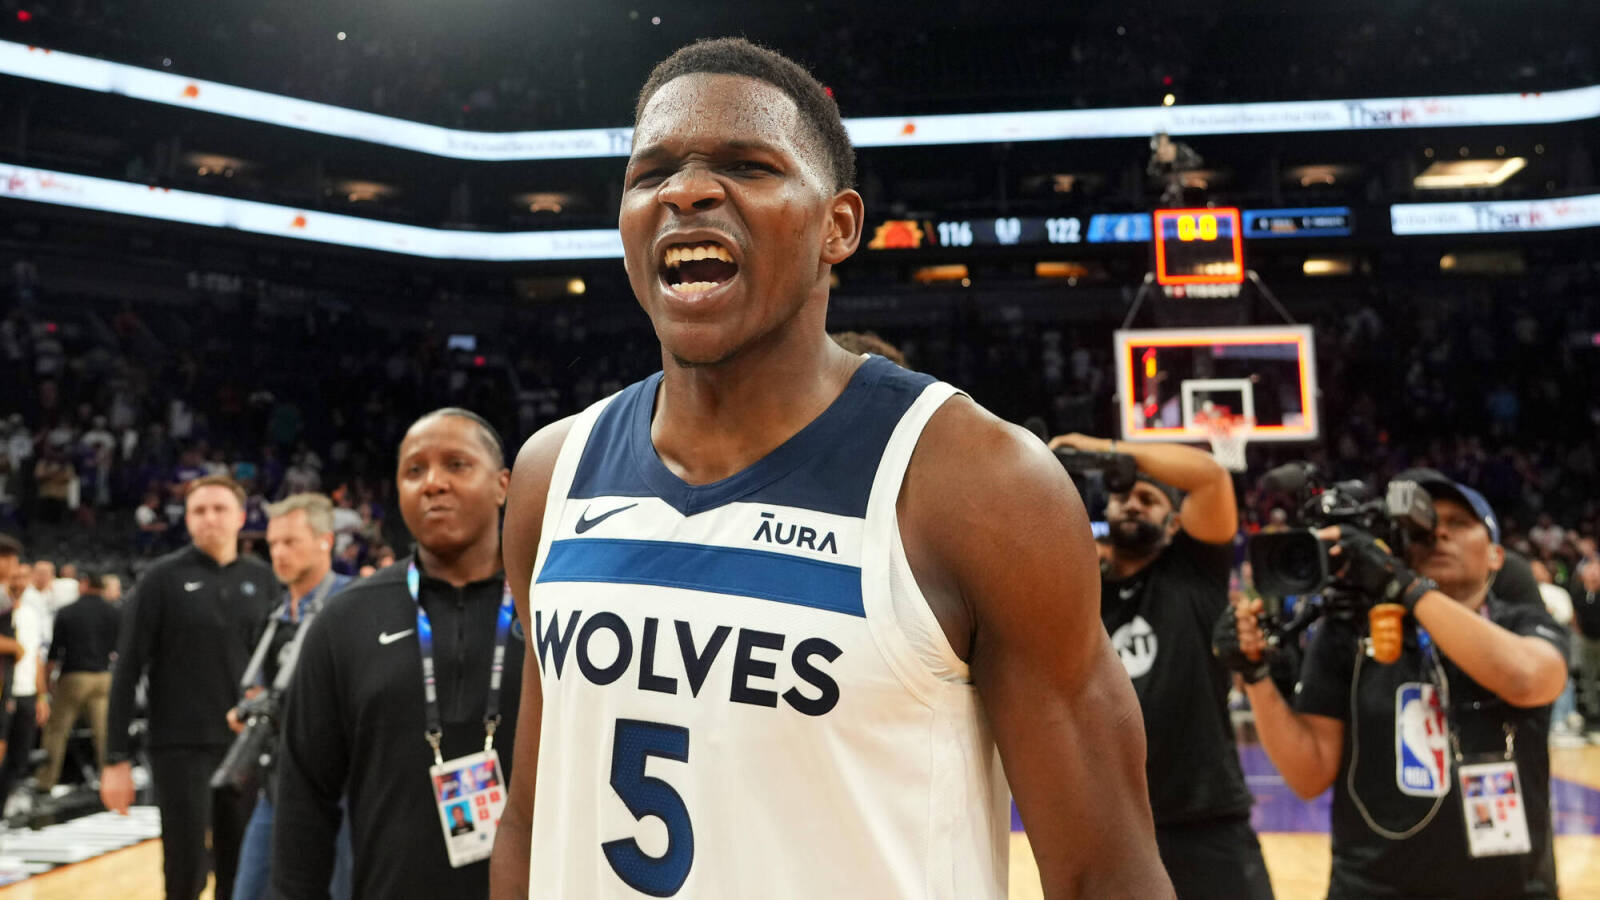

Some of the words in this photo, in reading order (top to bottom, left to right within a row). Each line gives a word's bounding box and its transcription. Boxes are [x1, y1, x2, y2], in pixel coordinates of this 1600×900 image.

[937, 221, 973, 247] 116
[1045, 217, 1081, 243] 122
[535, 608, 843, 716] WOLVES
[601, 717, 694, 898] 5
